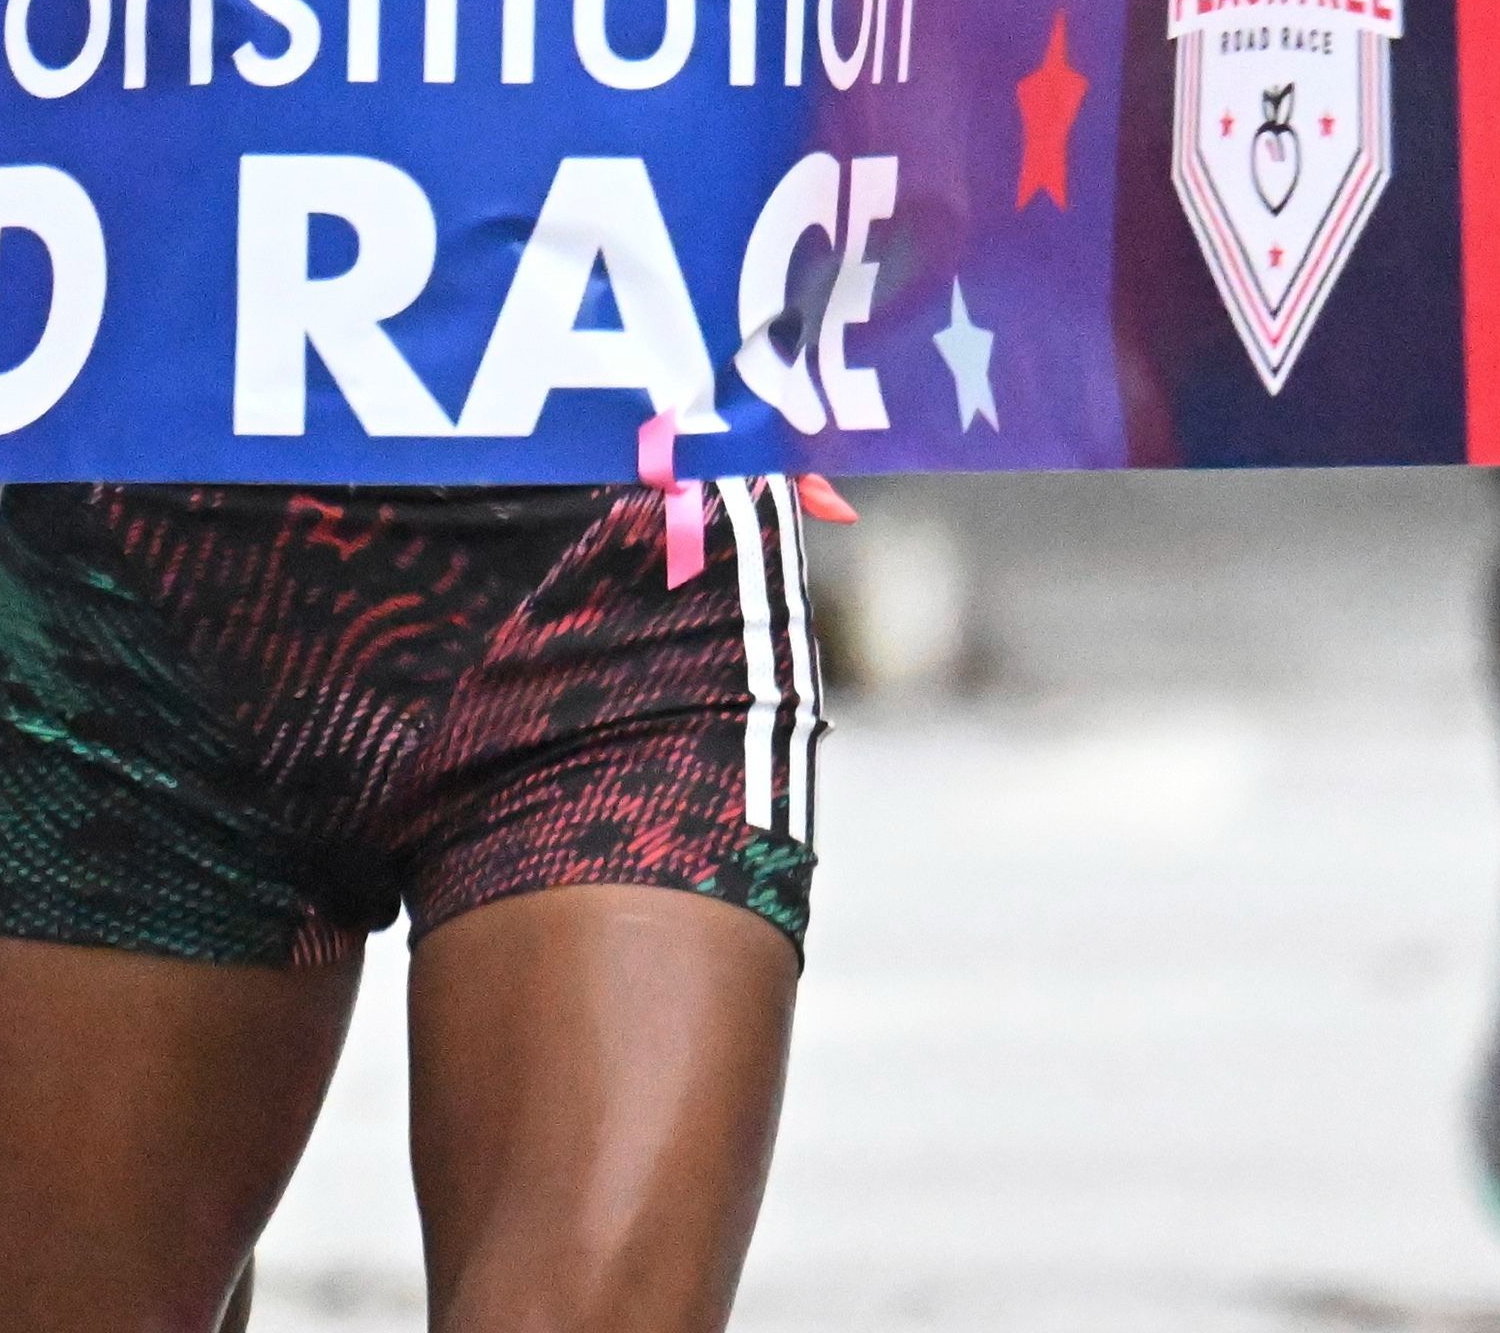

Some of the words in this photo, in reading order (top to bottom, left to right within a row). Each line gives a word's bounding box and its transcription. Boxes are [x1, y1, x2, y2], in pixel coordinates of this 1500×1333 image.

[1220, 25, 1270, 56] ROAD
[1280, 25, 1333, 56] RACE
[232, 151, 899, 437] RACE
